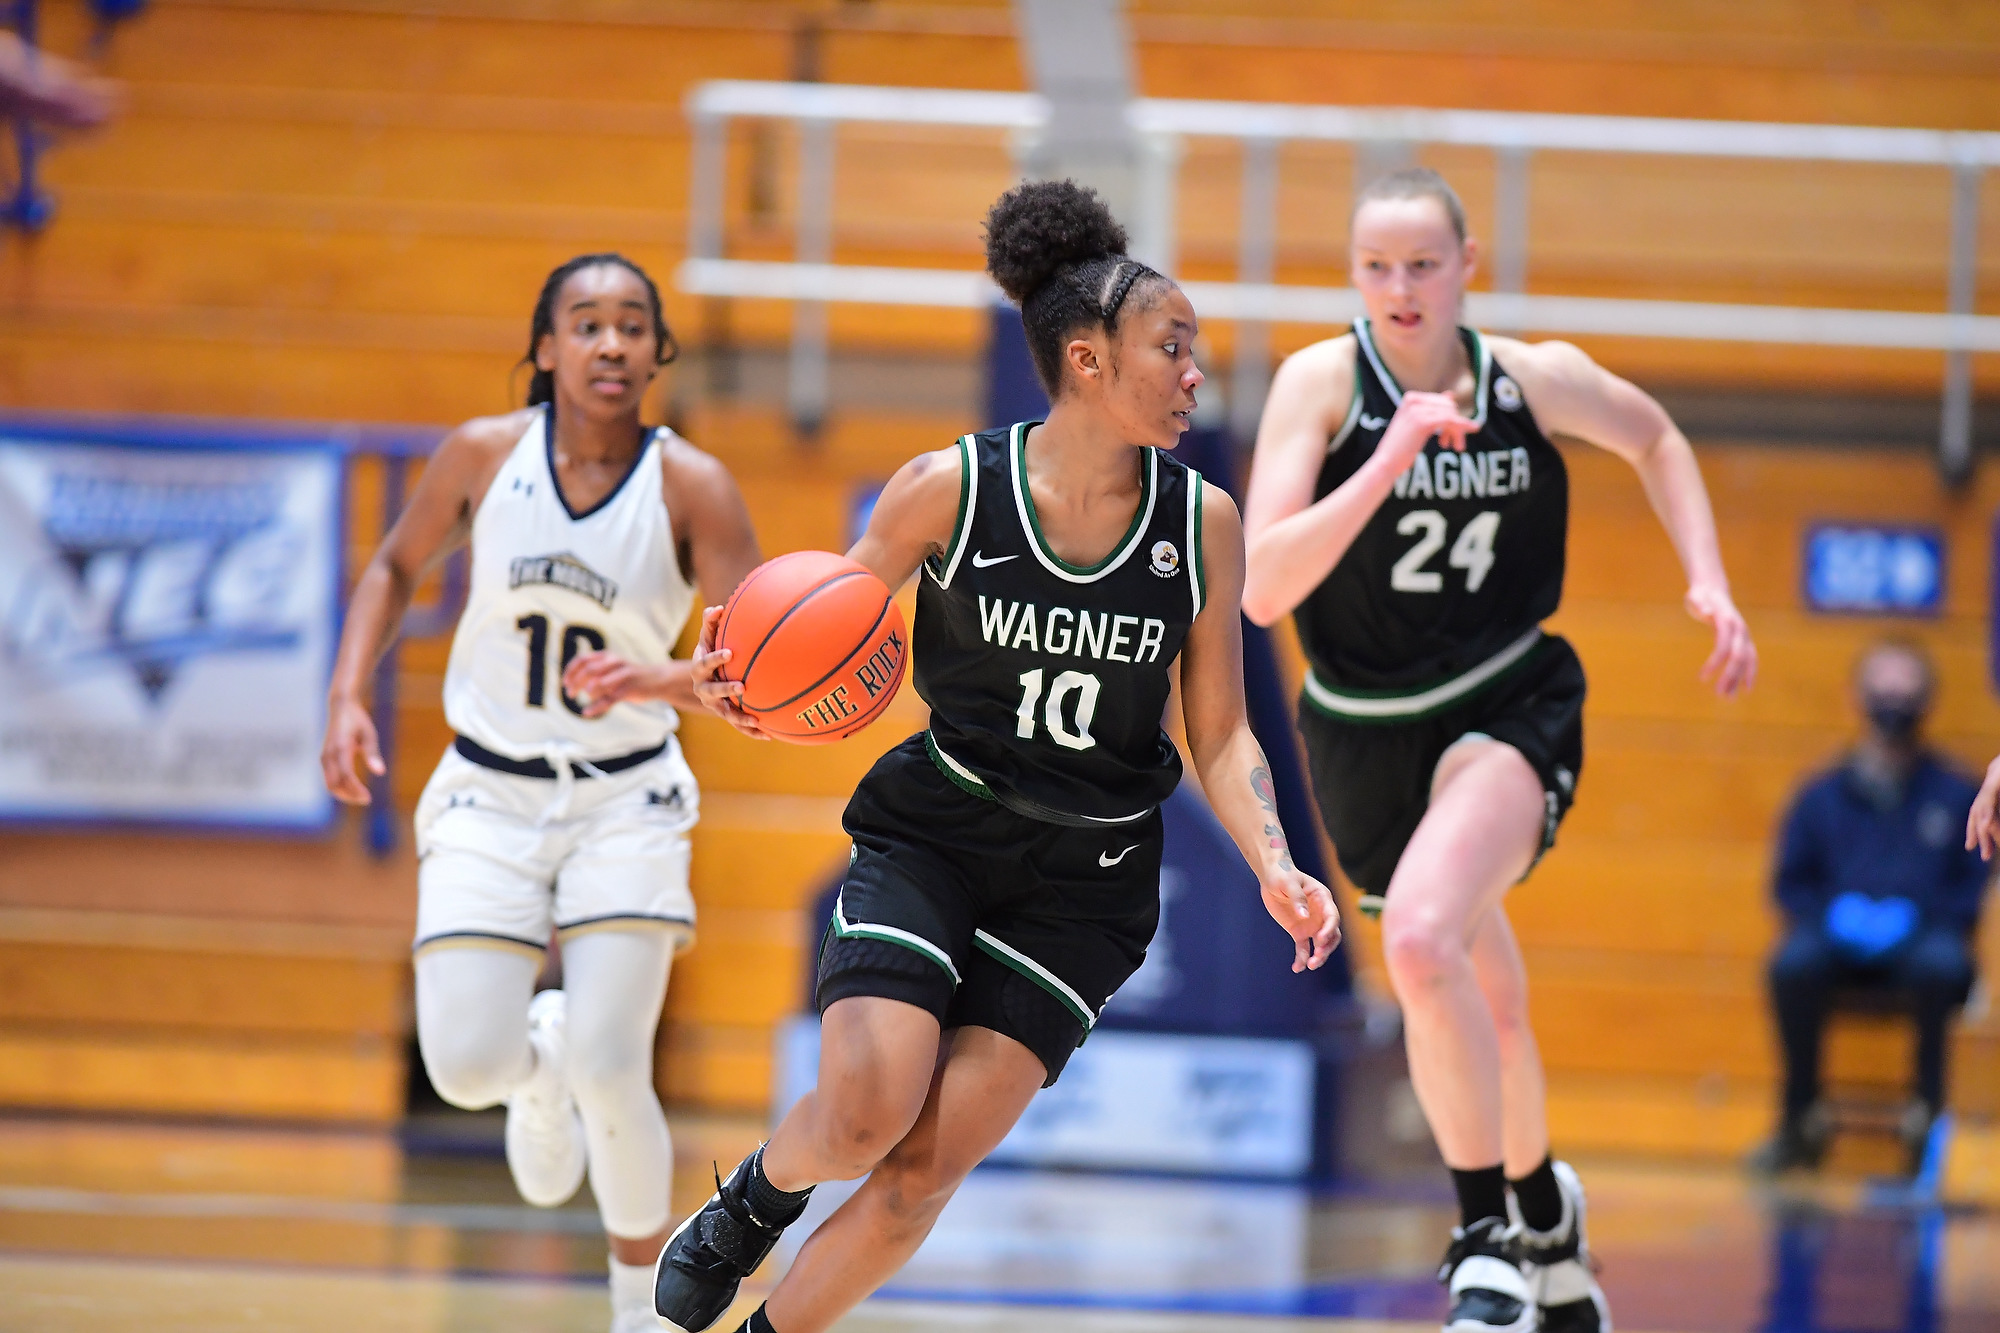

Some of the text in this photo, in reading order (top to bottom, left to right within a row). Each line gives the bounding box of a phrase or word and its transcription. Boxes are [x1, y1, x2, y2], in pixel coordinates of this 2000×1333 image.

[1390, 508, 1501, 594] 24
[978, 594, 1166, 663] WAGNER
[797, 629, 902, 728] THE ROCK
[1015, 667, 1102, 751] 10
